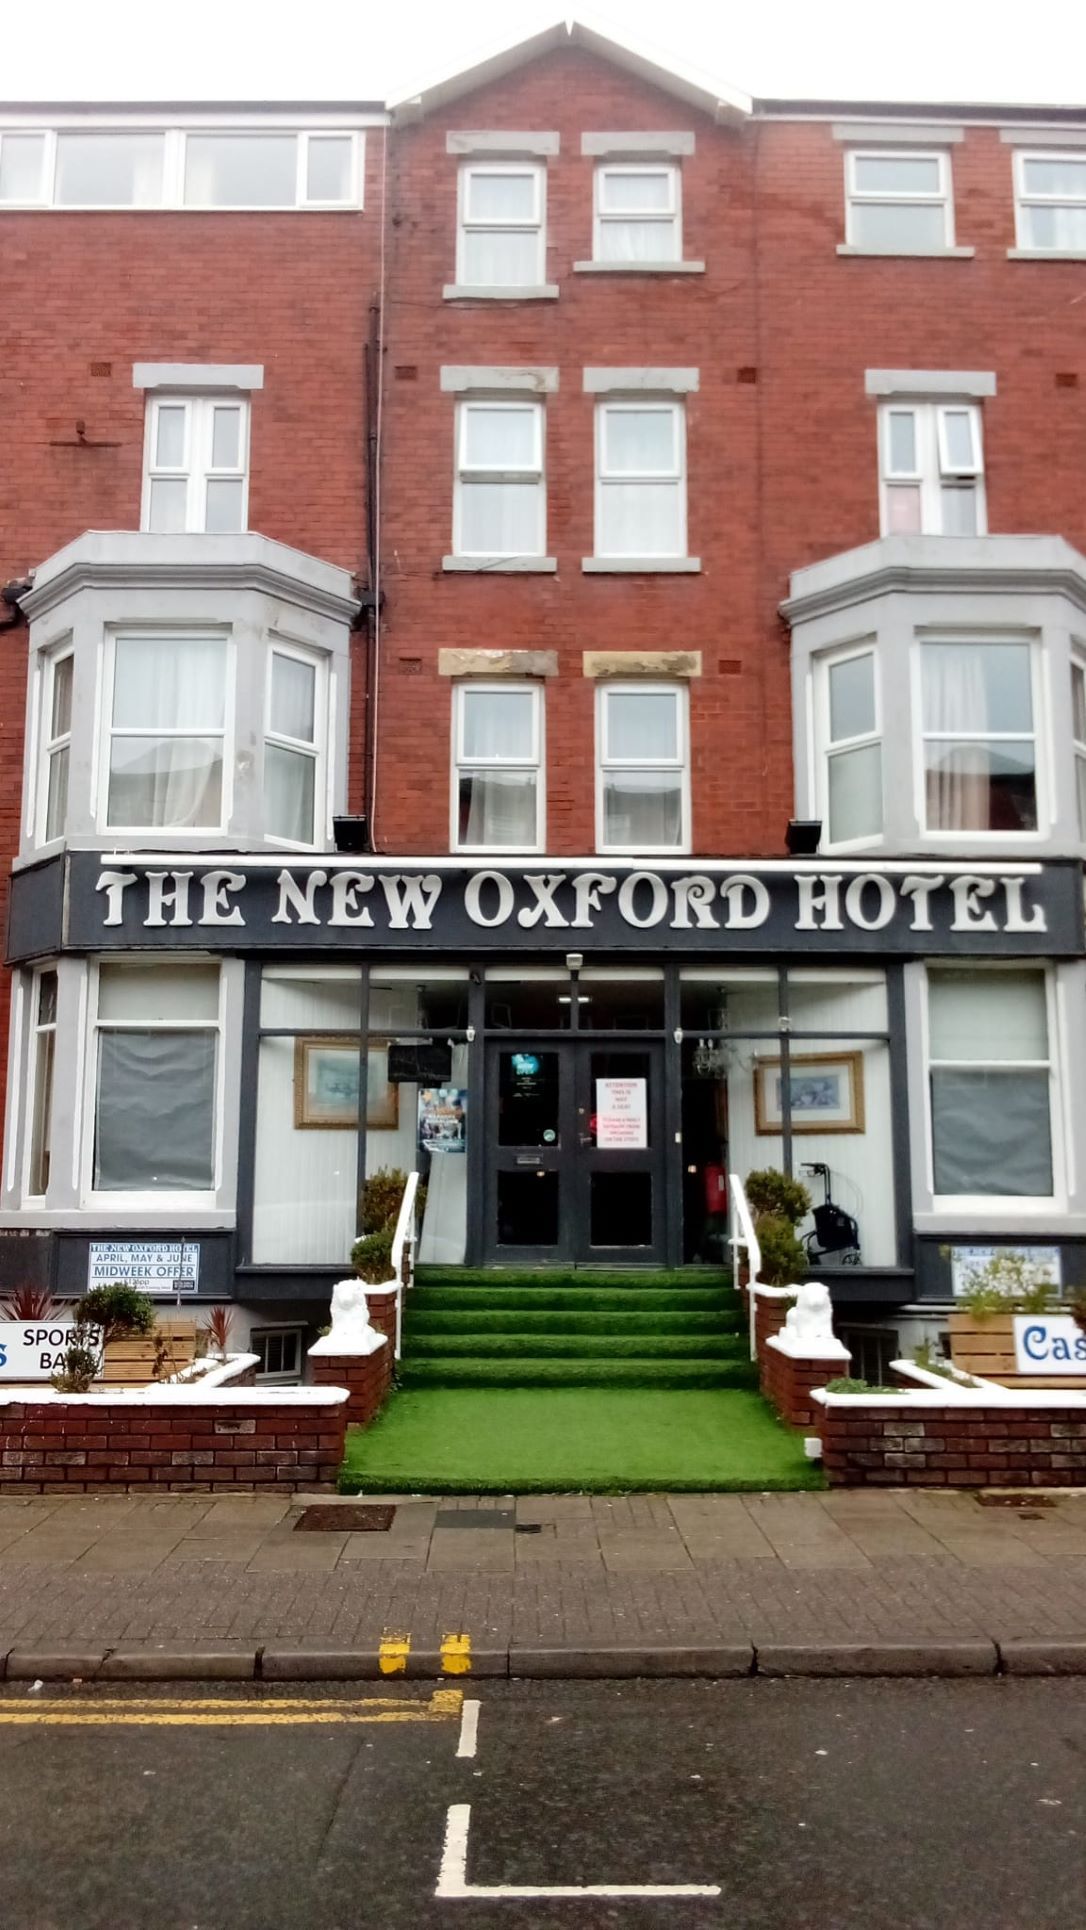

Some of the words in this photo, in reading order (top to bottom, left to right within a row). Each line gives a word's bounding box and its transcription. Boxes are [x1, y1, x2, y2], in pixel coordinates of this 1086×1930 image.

[95, 871, 246, 927] THE
[271, 869, 443, 929] NEW
[464, 870, 770, 930] OXFORD
[794, 873, 1048, 933] HOTEL
[96, 1253, 128, 1263] APRIL,
[131, 1253, 152, 1262] MAY
[157, 1254, 163, 1262] &
[95, 1266, 151, 1276] MIDWEEK
[157, 1267, 194, 1277] OFFER
